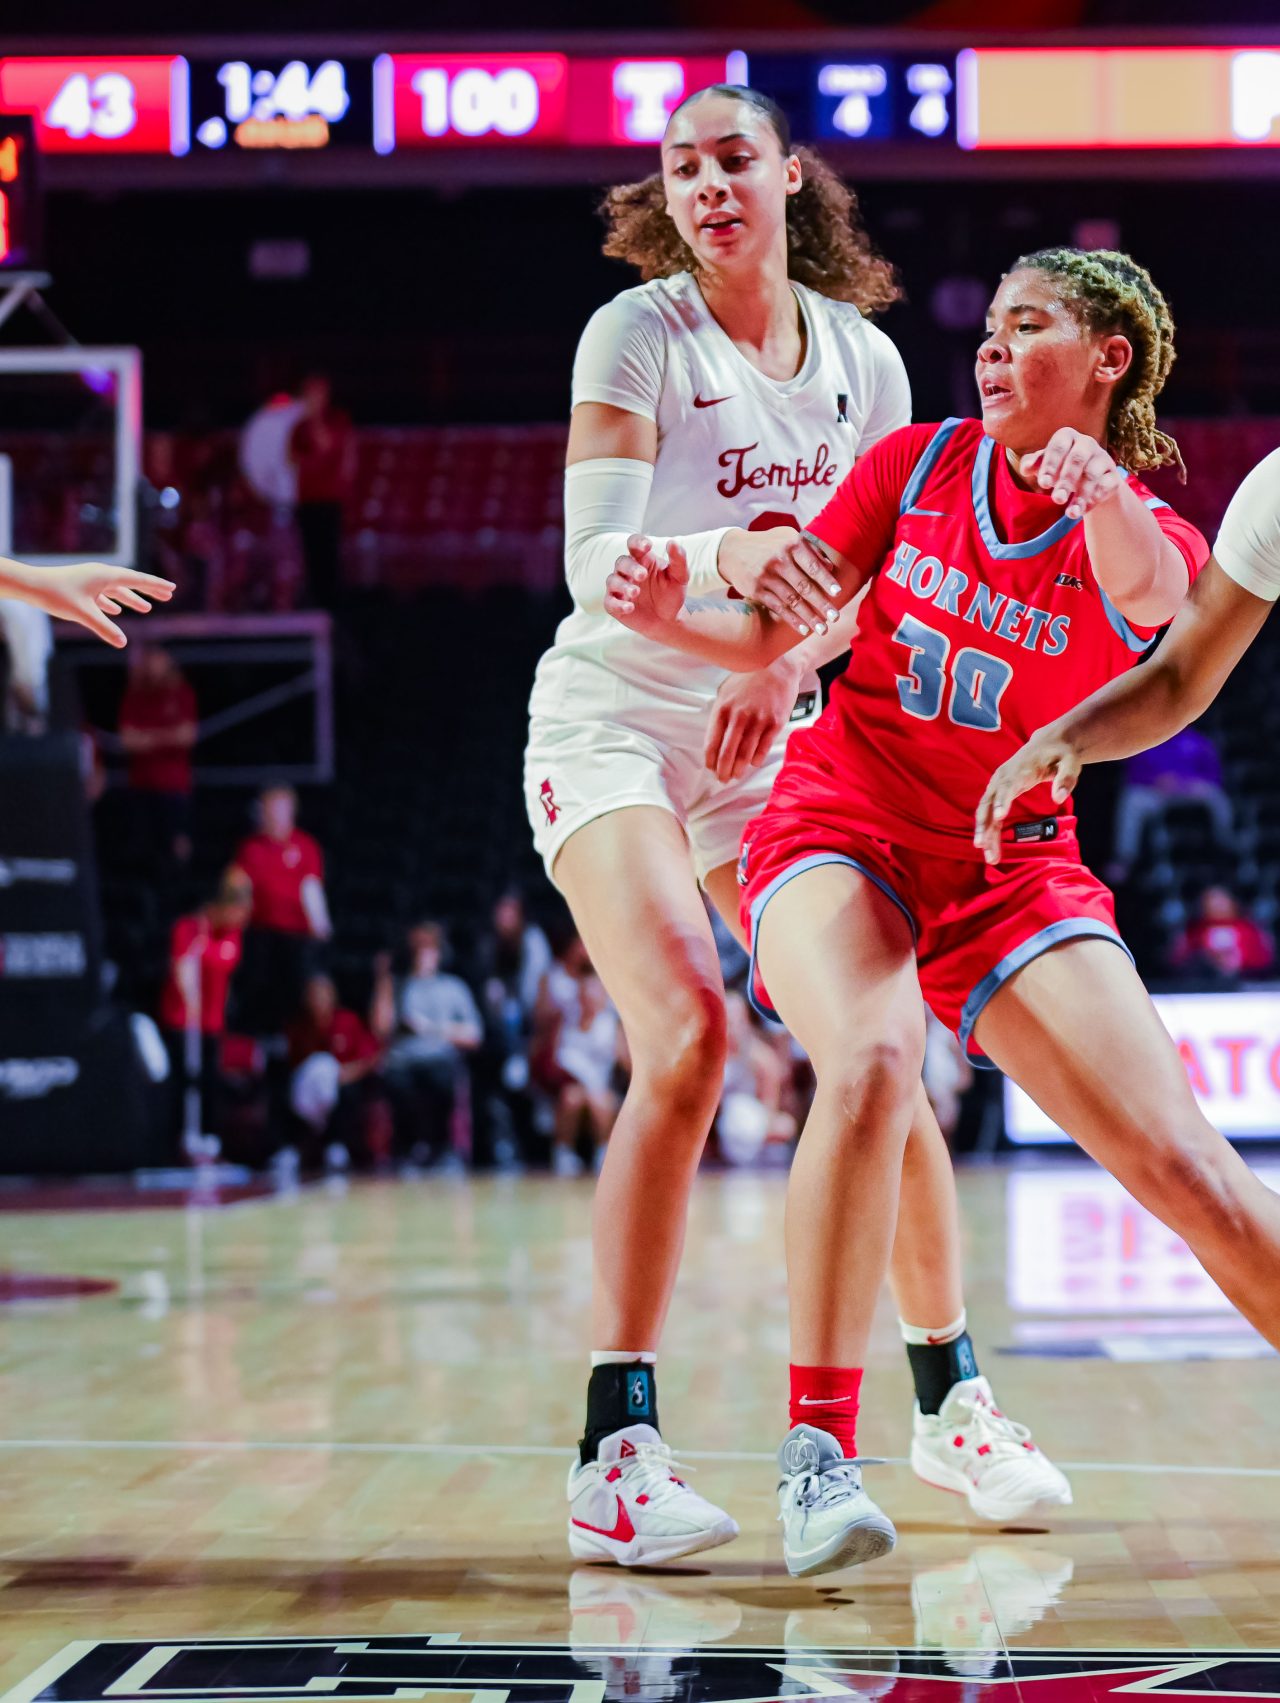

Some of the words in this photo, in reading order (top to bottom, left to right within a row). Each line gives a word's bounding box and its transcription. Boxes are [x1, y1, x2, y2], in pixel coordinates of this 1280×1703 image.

[46, 74, 137, 139] 43
[218, 60, 350, 121] 1:44
[412, 67, 540, 138] 100
[717, 441, 838, 502] Temple
[886, 540, 1070, 656] HORNETS
[891, 612, 1013, 732] 30
